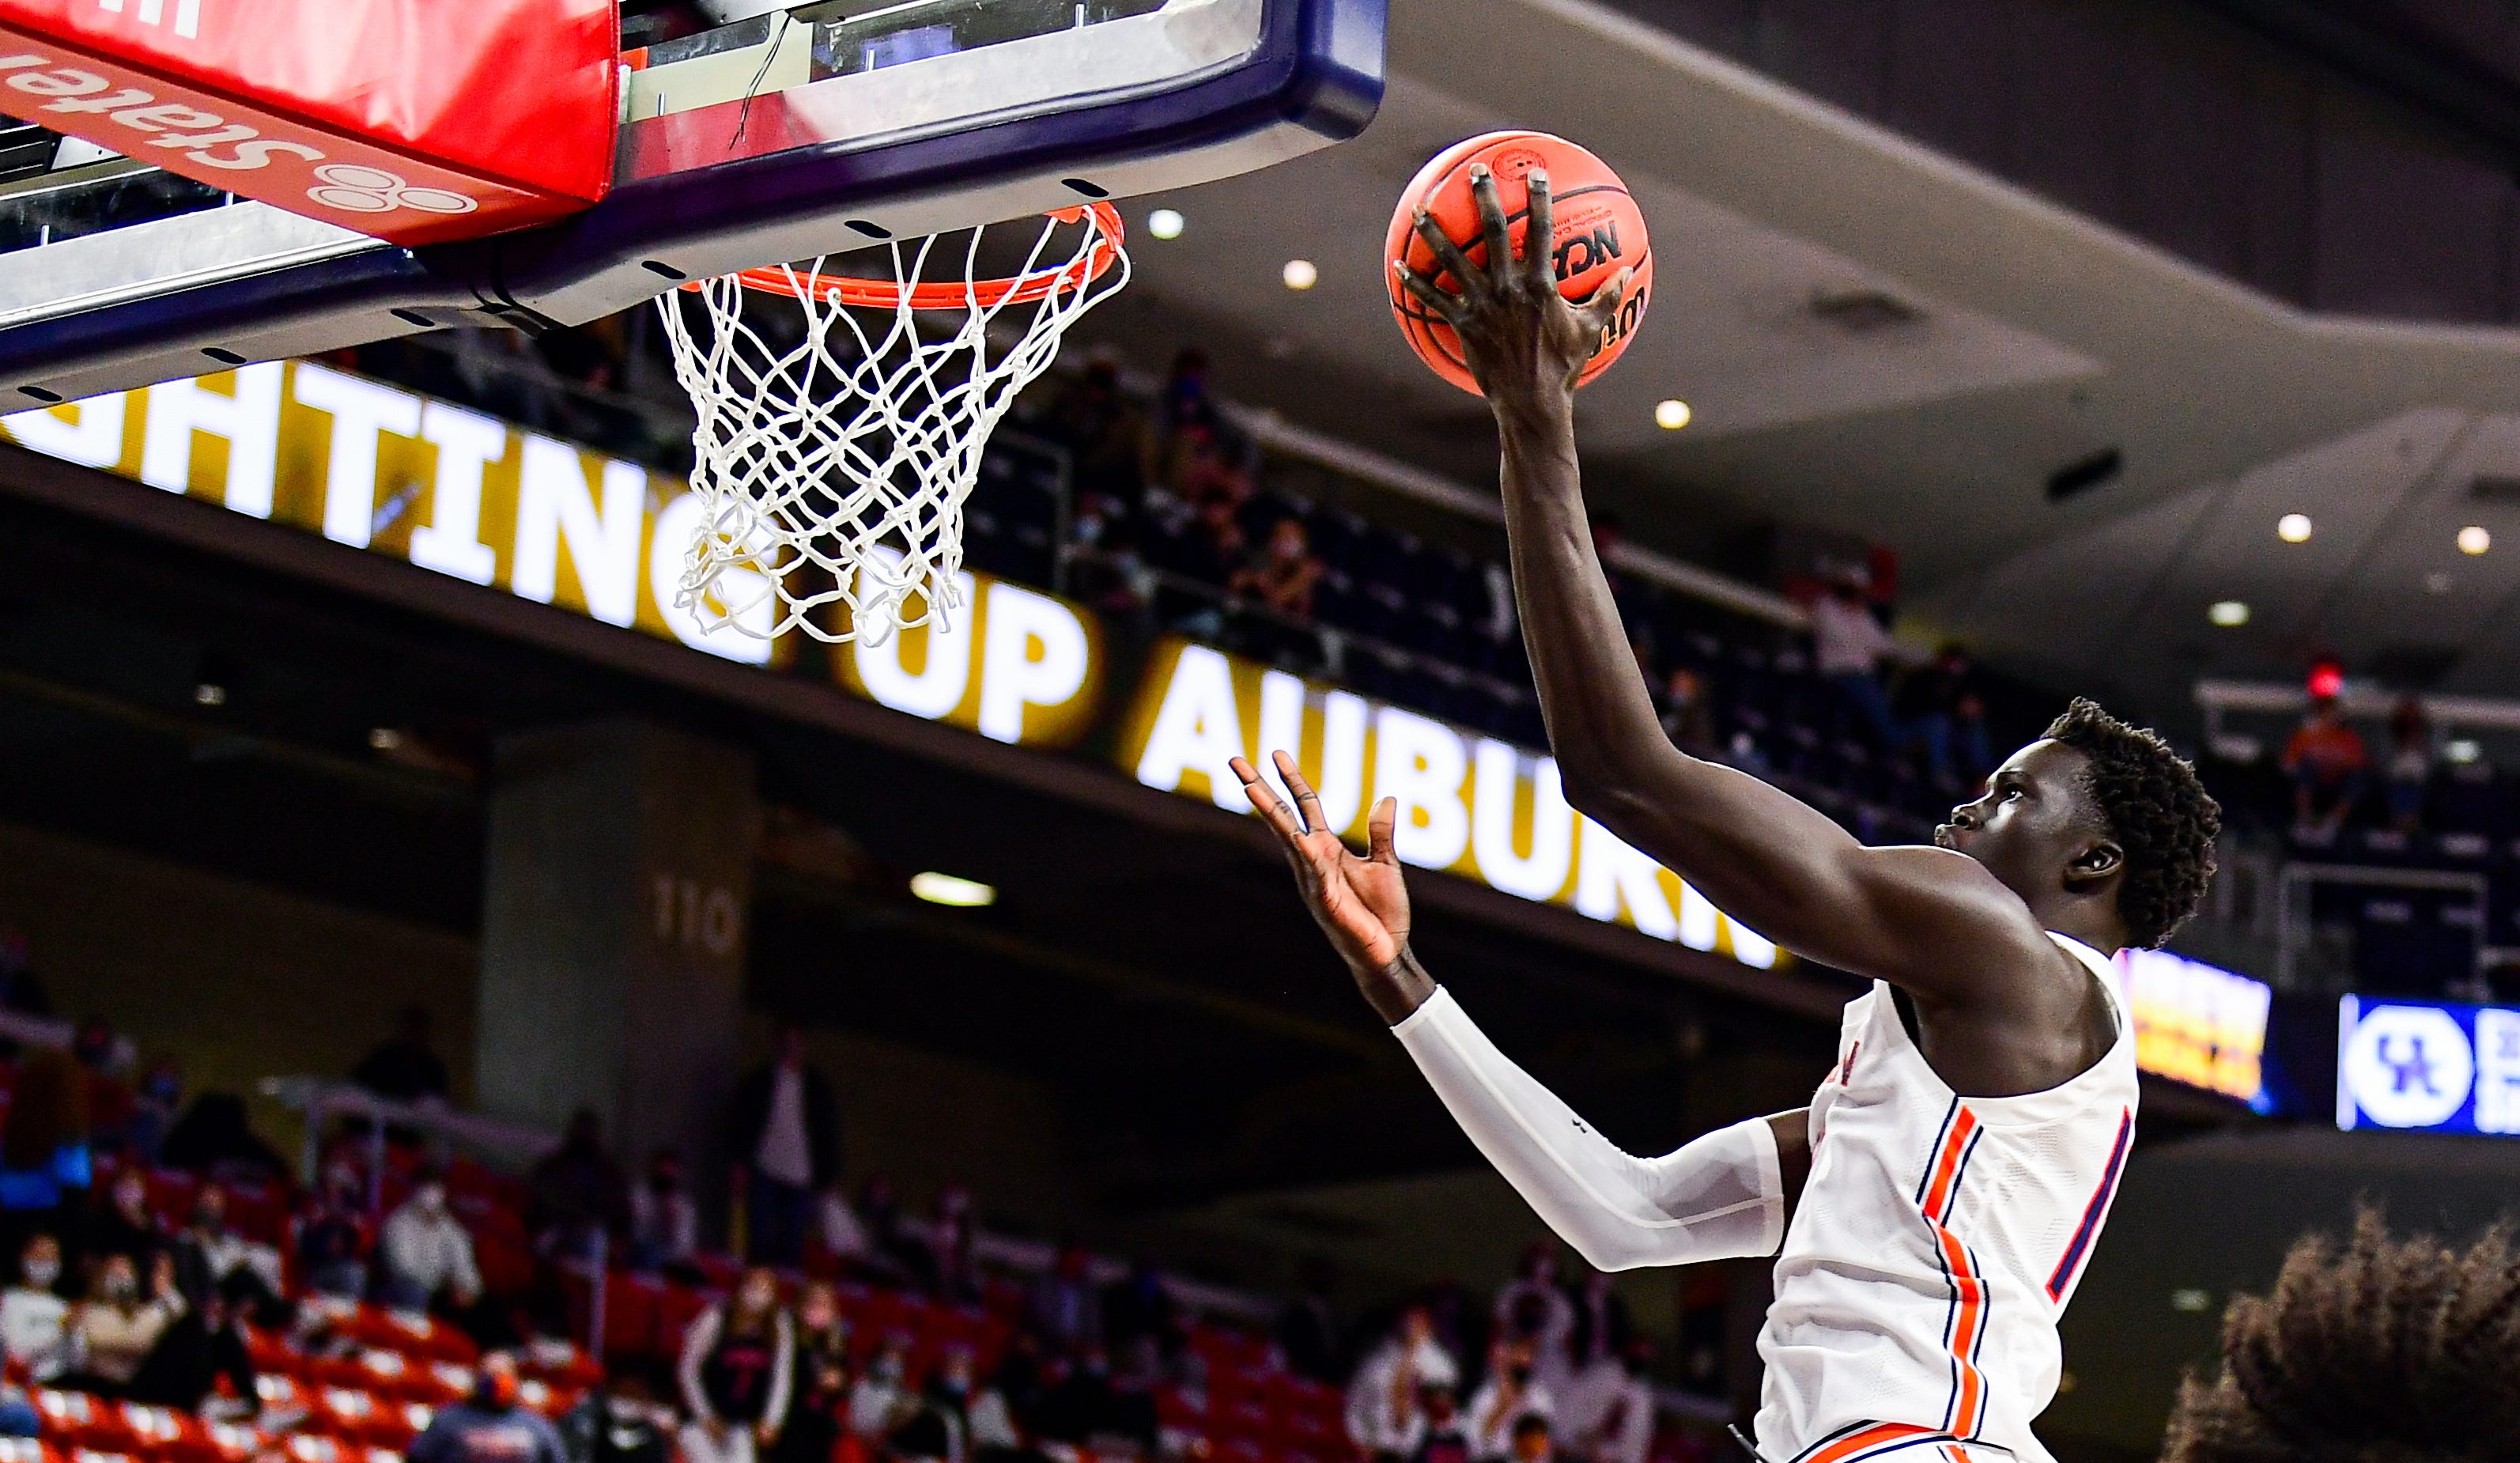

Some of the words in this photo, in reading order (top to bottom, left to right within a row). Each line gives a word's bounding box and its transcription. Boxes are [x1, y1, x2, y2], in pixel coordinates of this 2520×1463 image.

[1552, 221, 1622, 282] NCA
[855, 542, 1089, 744] UP
[656, 875, 742, 952] 110
